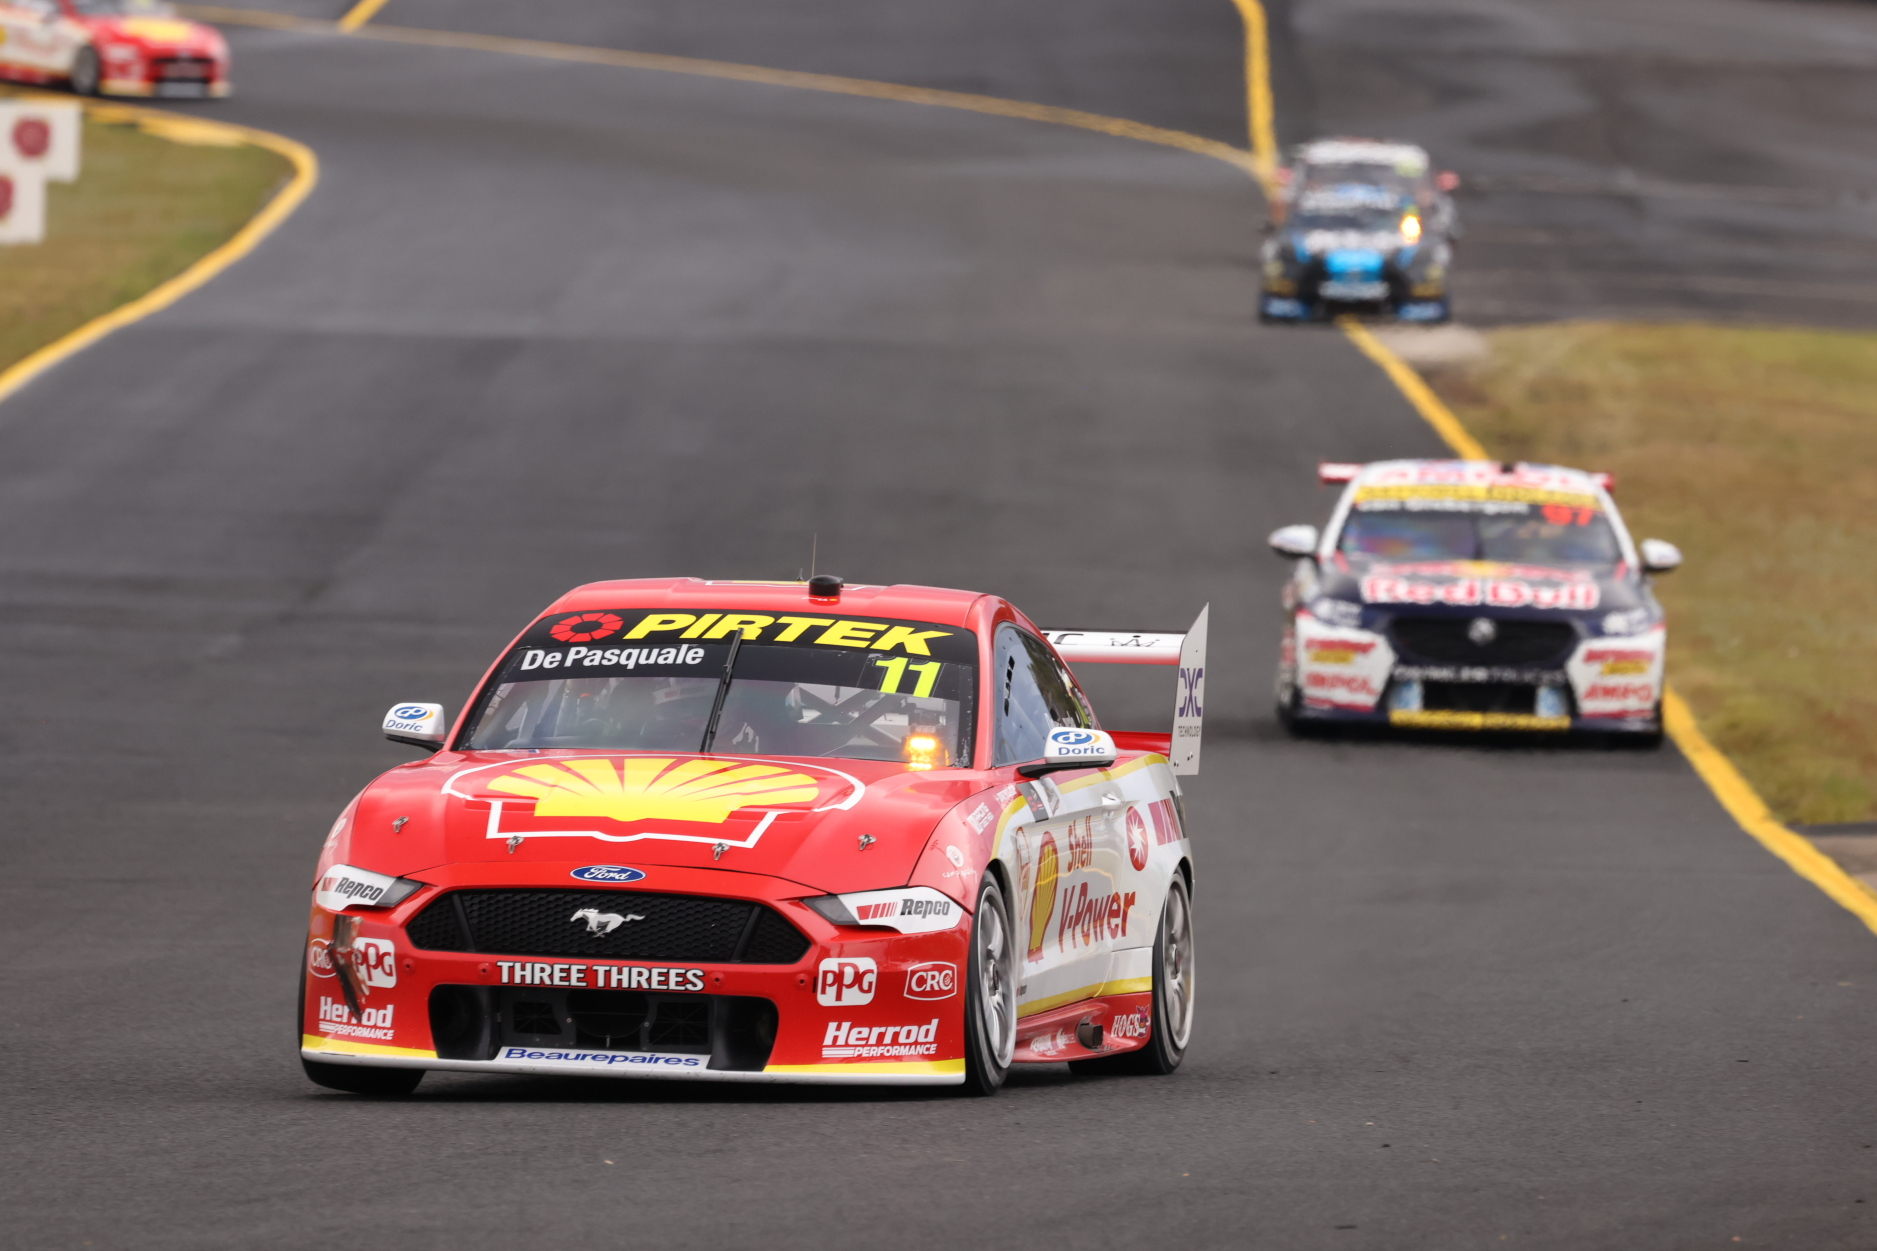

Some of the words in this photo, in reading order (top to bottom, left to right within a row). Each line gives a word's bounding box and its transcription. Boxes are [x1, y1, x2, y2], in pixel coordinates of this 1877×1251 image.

[1363, 576, 1481, 604] Red
[622, 613, 955, 657] PIRTEK
[520, 649, 562, 671] De
[564, 644, 705, 669] Pasquale
[874, 656, 942, 698] 11
[385, 719, 423, 732] Doric
[1058, 745, 1106, 756] Doric
[1067, 815, 1093, 873] Shell
[583, 866, 633, 880] Ford
[334, 876, 384, 901] Repco
[900, 899, 951, 919] Repco
[1058, 881, 1137, 953] V-Power
[497, 961, 588, 987] THREE
[592, 965, 706, 991] THREES
[820, 962, 875, 1002] PPG
[911, 970, 954, 991] CRC
[335, 1023, 395, 1040] PERFORMANCE
[822, 1018, 940, 1046] Herrod
[504, 1048, 700, 1065] Beaurepaires
[853, 1043, 938, 1058] PERFORMANCE
